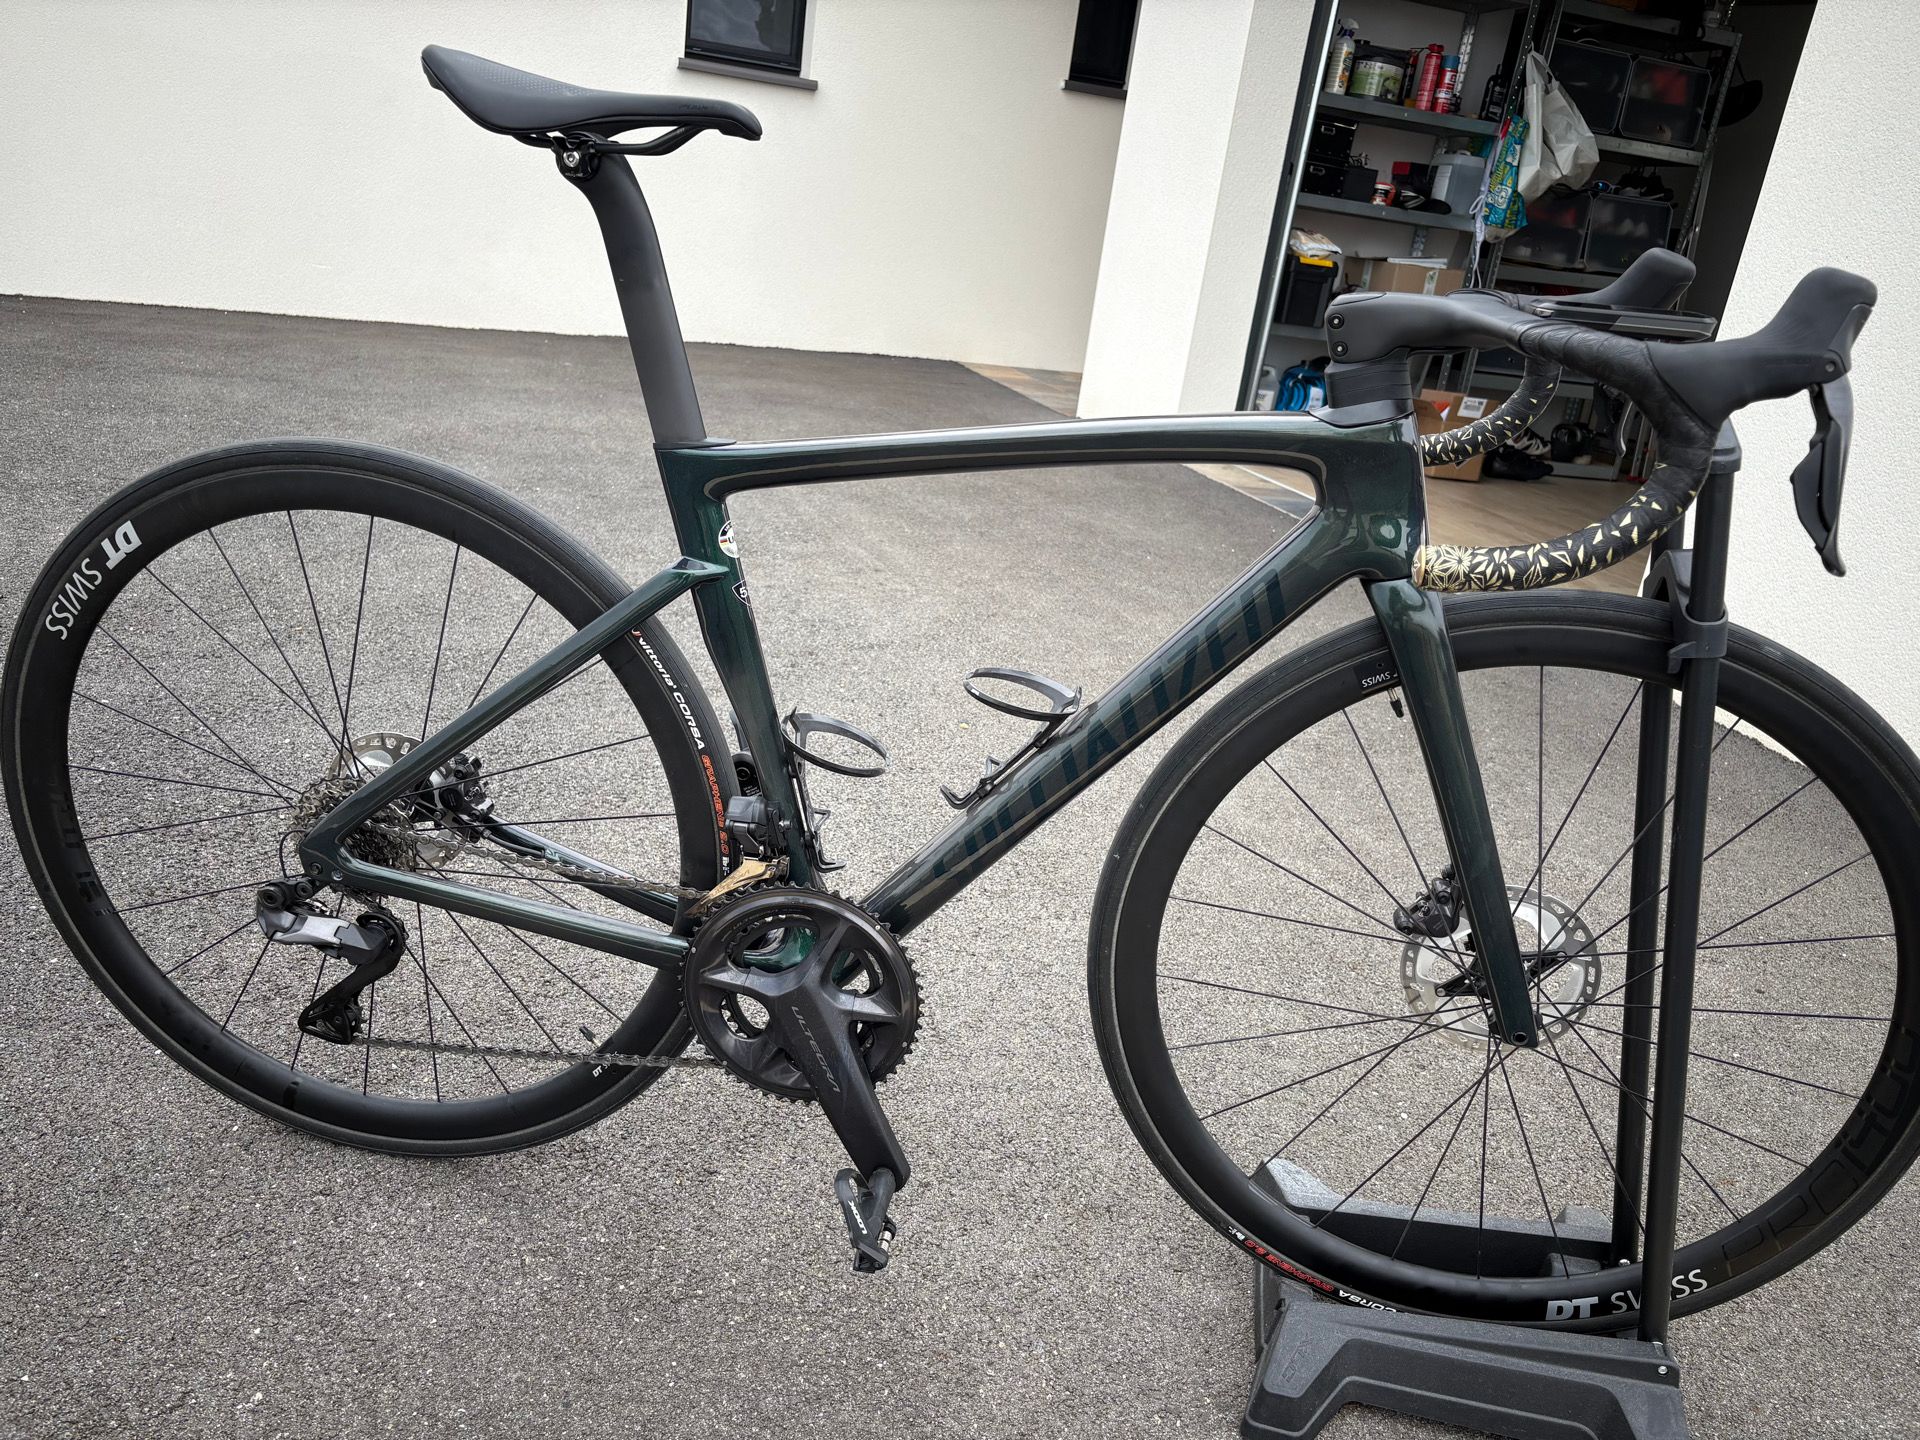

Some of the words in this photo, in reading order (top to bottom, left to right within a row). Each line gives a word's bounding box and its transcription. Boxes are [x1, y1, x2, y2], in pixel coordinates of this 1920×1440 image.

[101, 520, 142, 570] DT
[45, 557, 102, 640] SWISS
[1361, 671, 1391, 688] SWISS
[673, 691, 705, 750] CORSA
[791, 1006, 841, 1092] ULTEGRA
[847, 1200, 868, 1235] LOOK
[1264, 1253, 1335, 1292] GRAPHENE
[1545, 1296, 1599, 1321] DT
[1610, 1268, 1708, 1314] SSS
